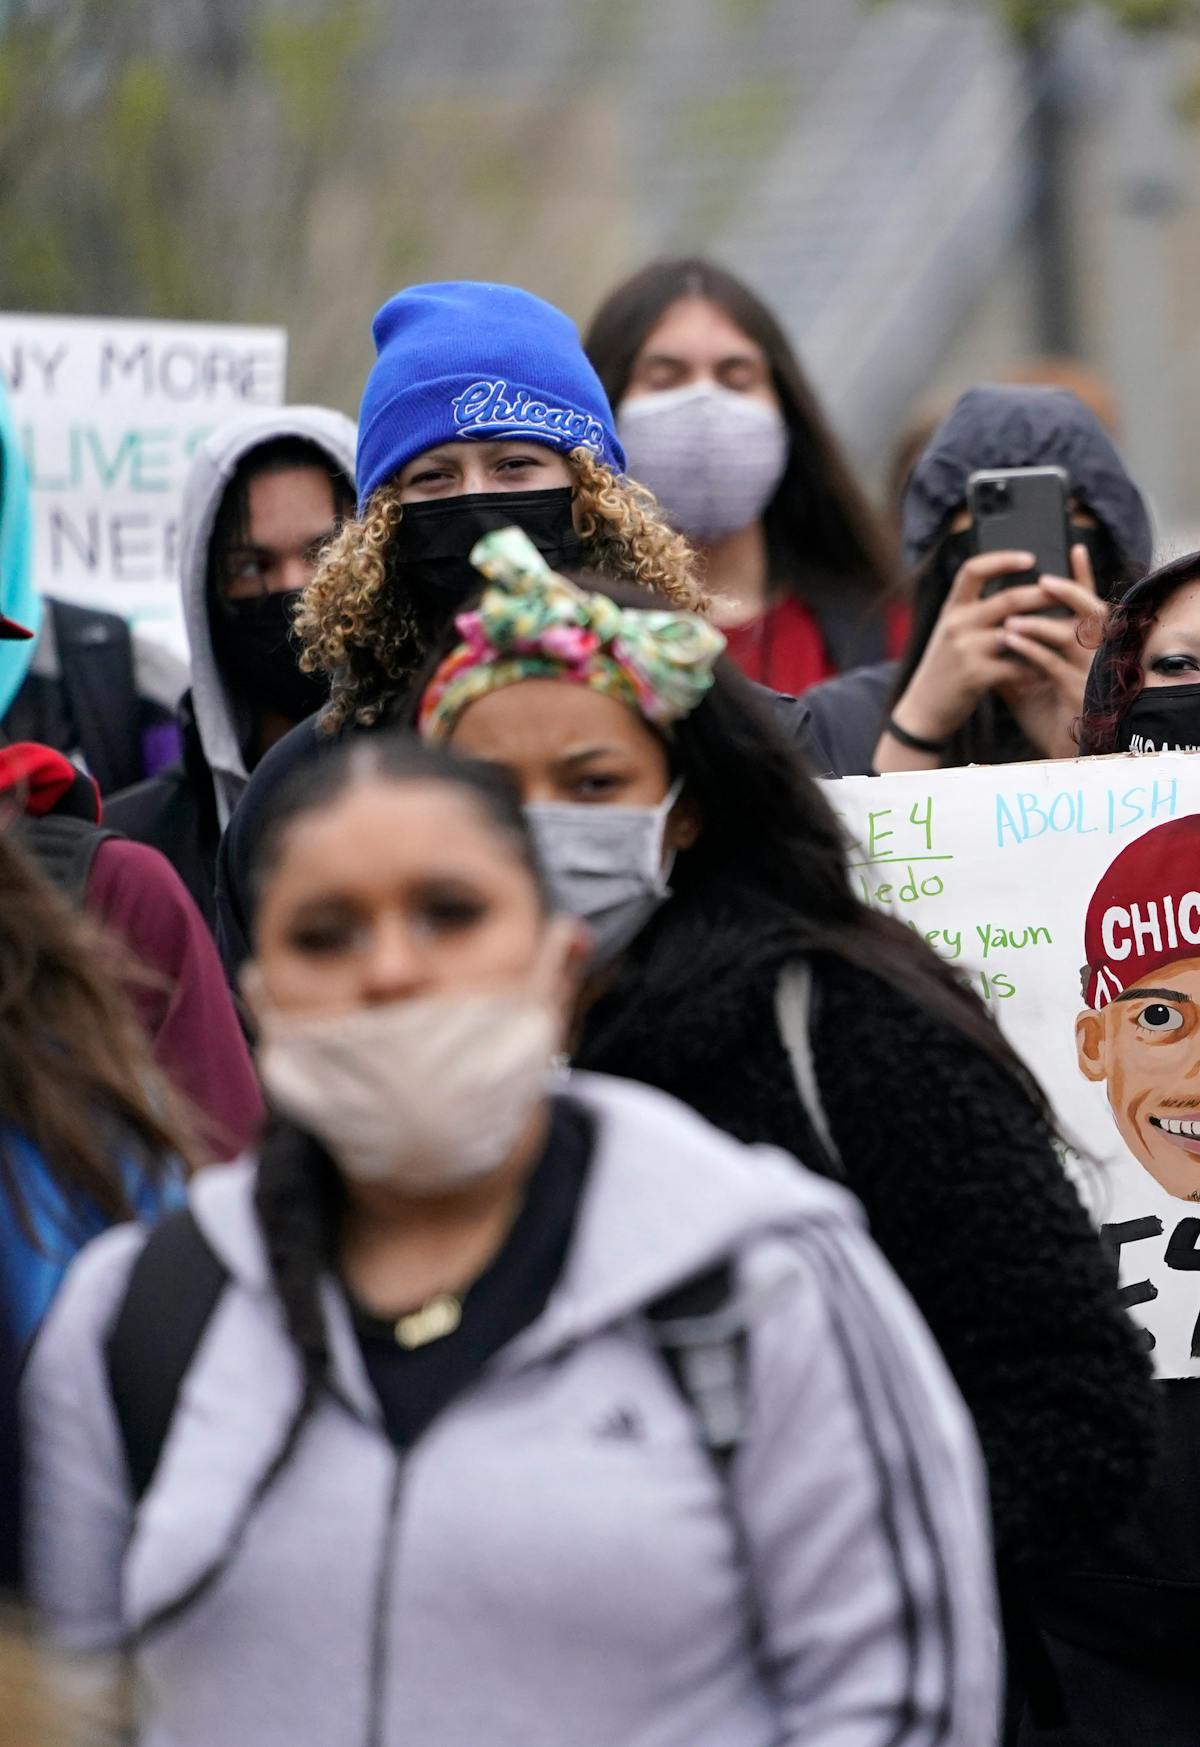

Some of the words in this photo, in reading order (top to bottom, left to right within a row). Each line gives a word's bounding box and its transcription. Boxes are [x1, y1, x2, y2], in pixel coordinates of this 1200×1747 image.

[101, 342, 272, 398] MORE
[450, 380, 604, 452] Chicago
[909, 797, 932, 850] 4
[994, 778, 1178, 848] ABOLISH
